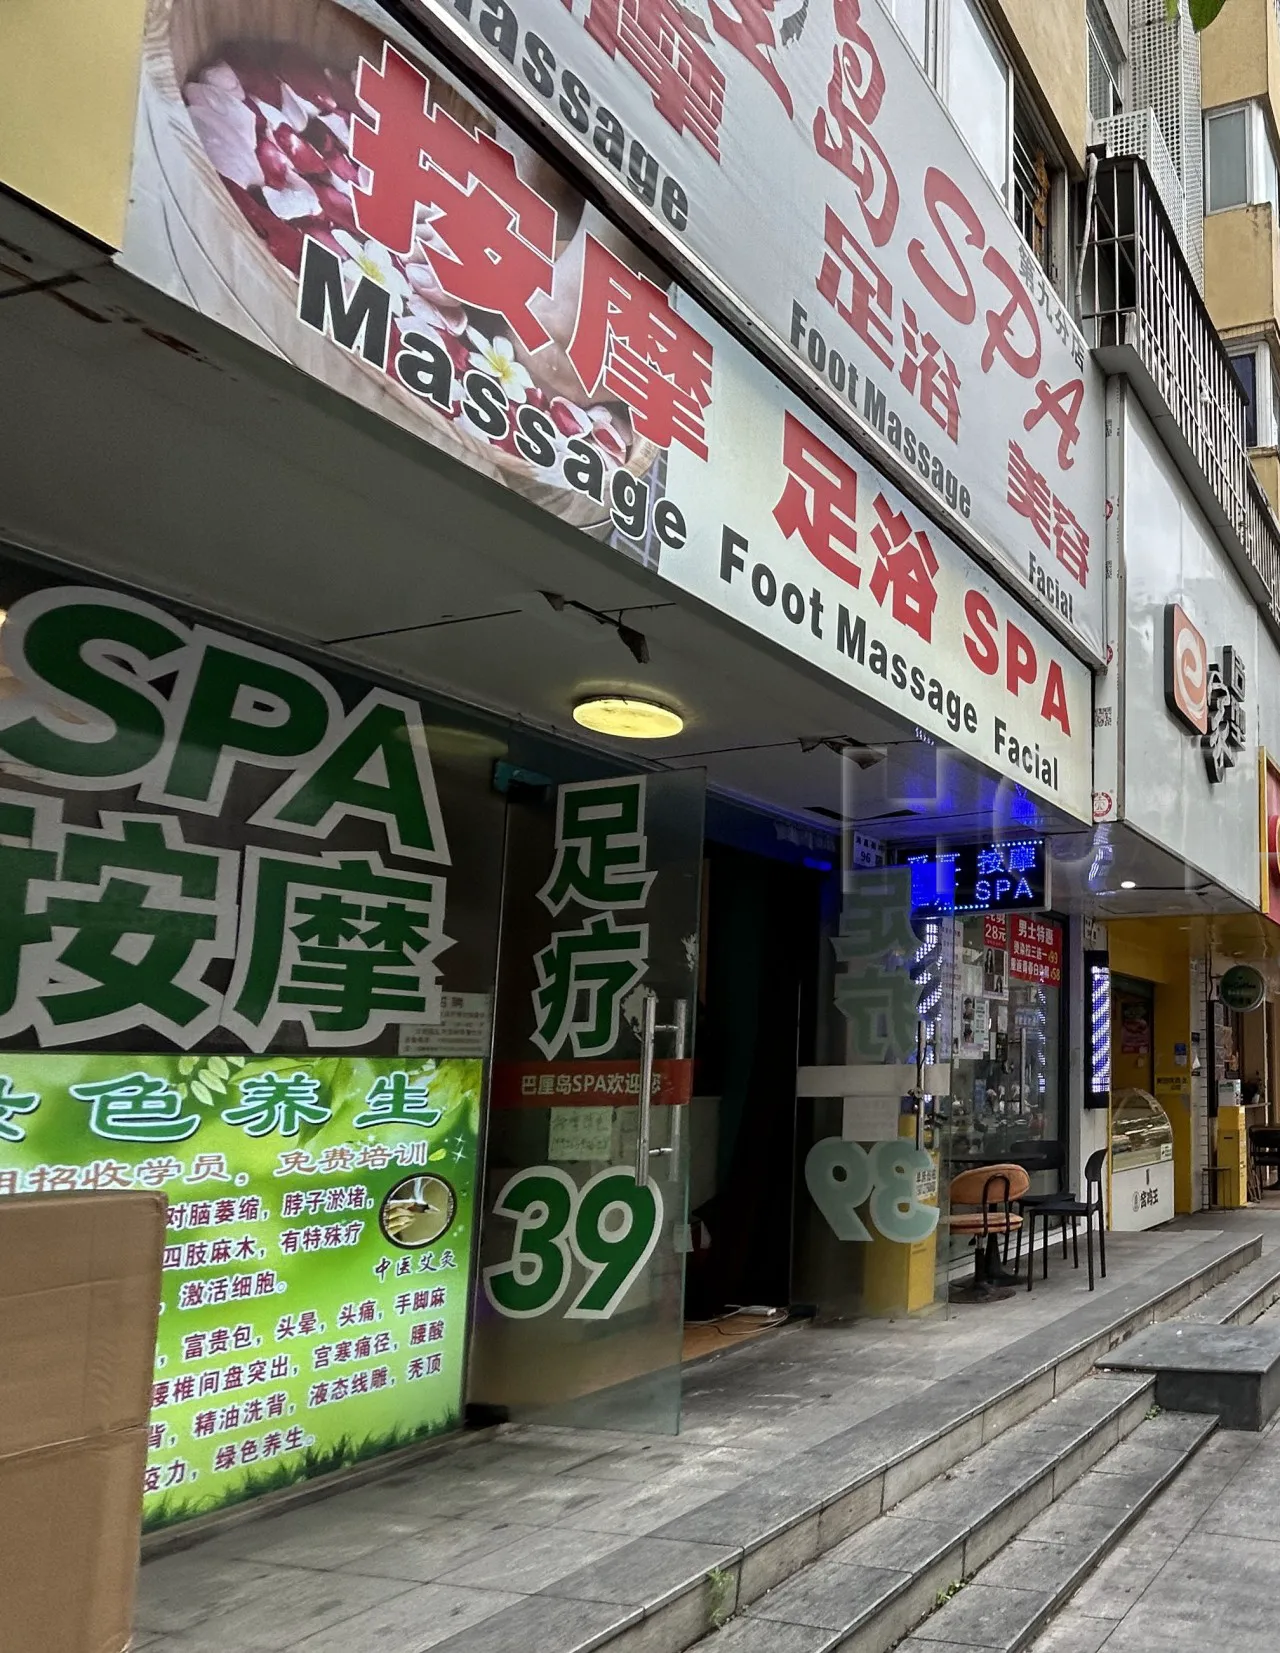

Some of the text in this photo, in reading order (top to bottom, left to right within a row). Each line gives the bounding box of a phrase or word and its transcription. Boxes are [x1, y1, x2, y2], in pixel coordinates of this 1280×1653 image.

[455, 0, 690, 232] assage
[347, 39, 714, 463] 按摩
[773, 410, 940, 646] 足浴
[963, 589, 1073, 737] SPA
[815, 204, 1090, 590] 足浴 美容
[1018, 244, 1086, 374] 第九分店
[298, 235, 1059, 792] Massage Foot Massage Facial
[790, 300, 1075, 623] Foot Massage Facial
[0, 587, 452, 865] SPA
[532, 775, 661, 1060] 足疗
[975, 877, 1034, 900] SPA
[977, 846, 1037, 874] 按摩
[985, 923, 1006, 943] 28元
[1018, 919, 1054, 946] 男士特惠
[373, 1251, 457, 1281] 中医艾灸
[483, 1166, 664, 1320] 39
